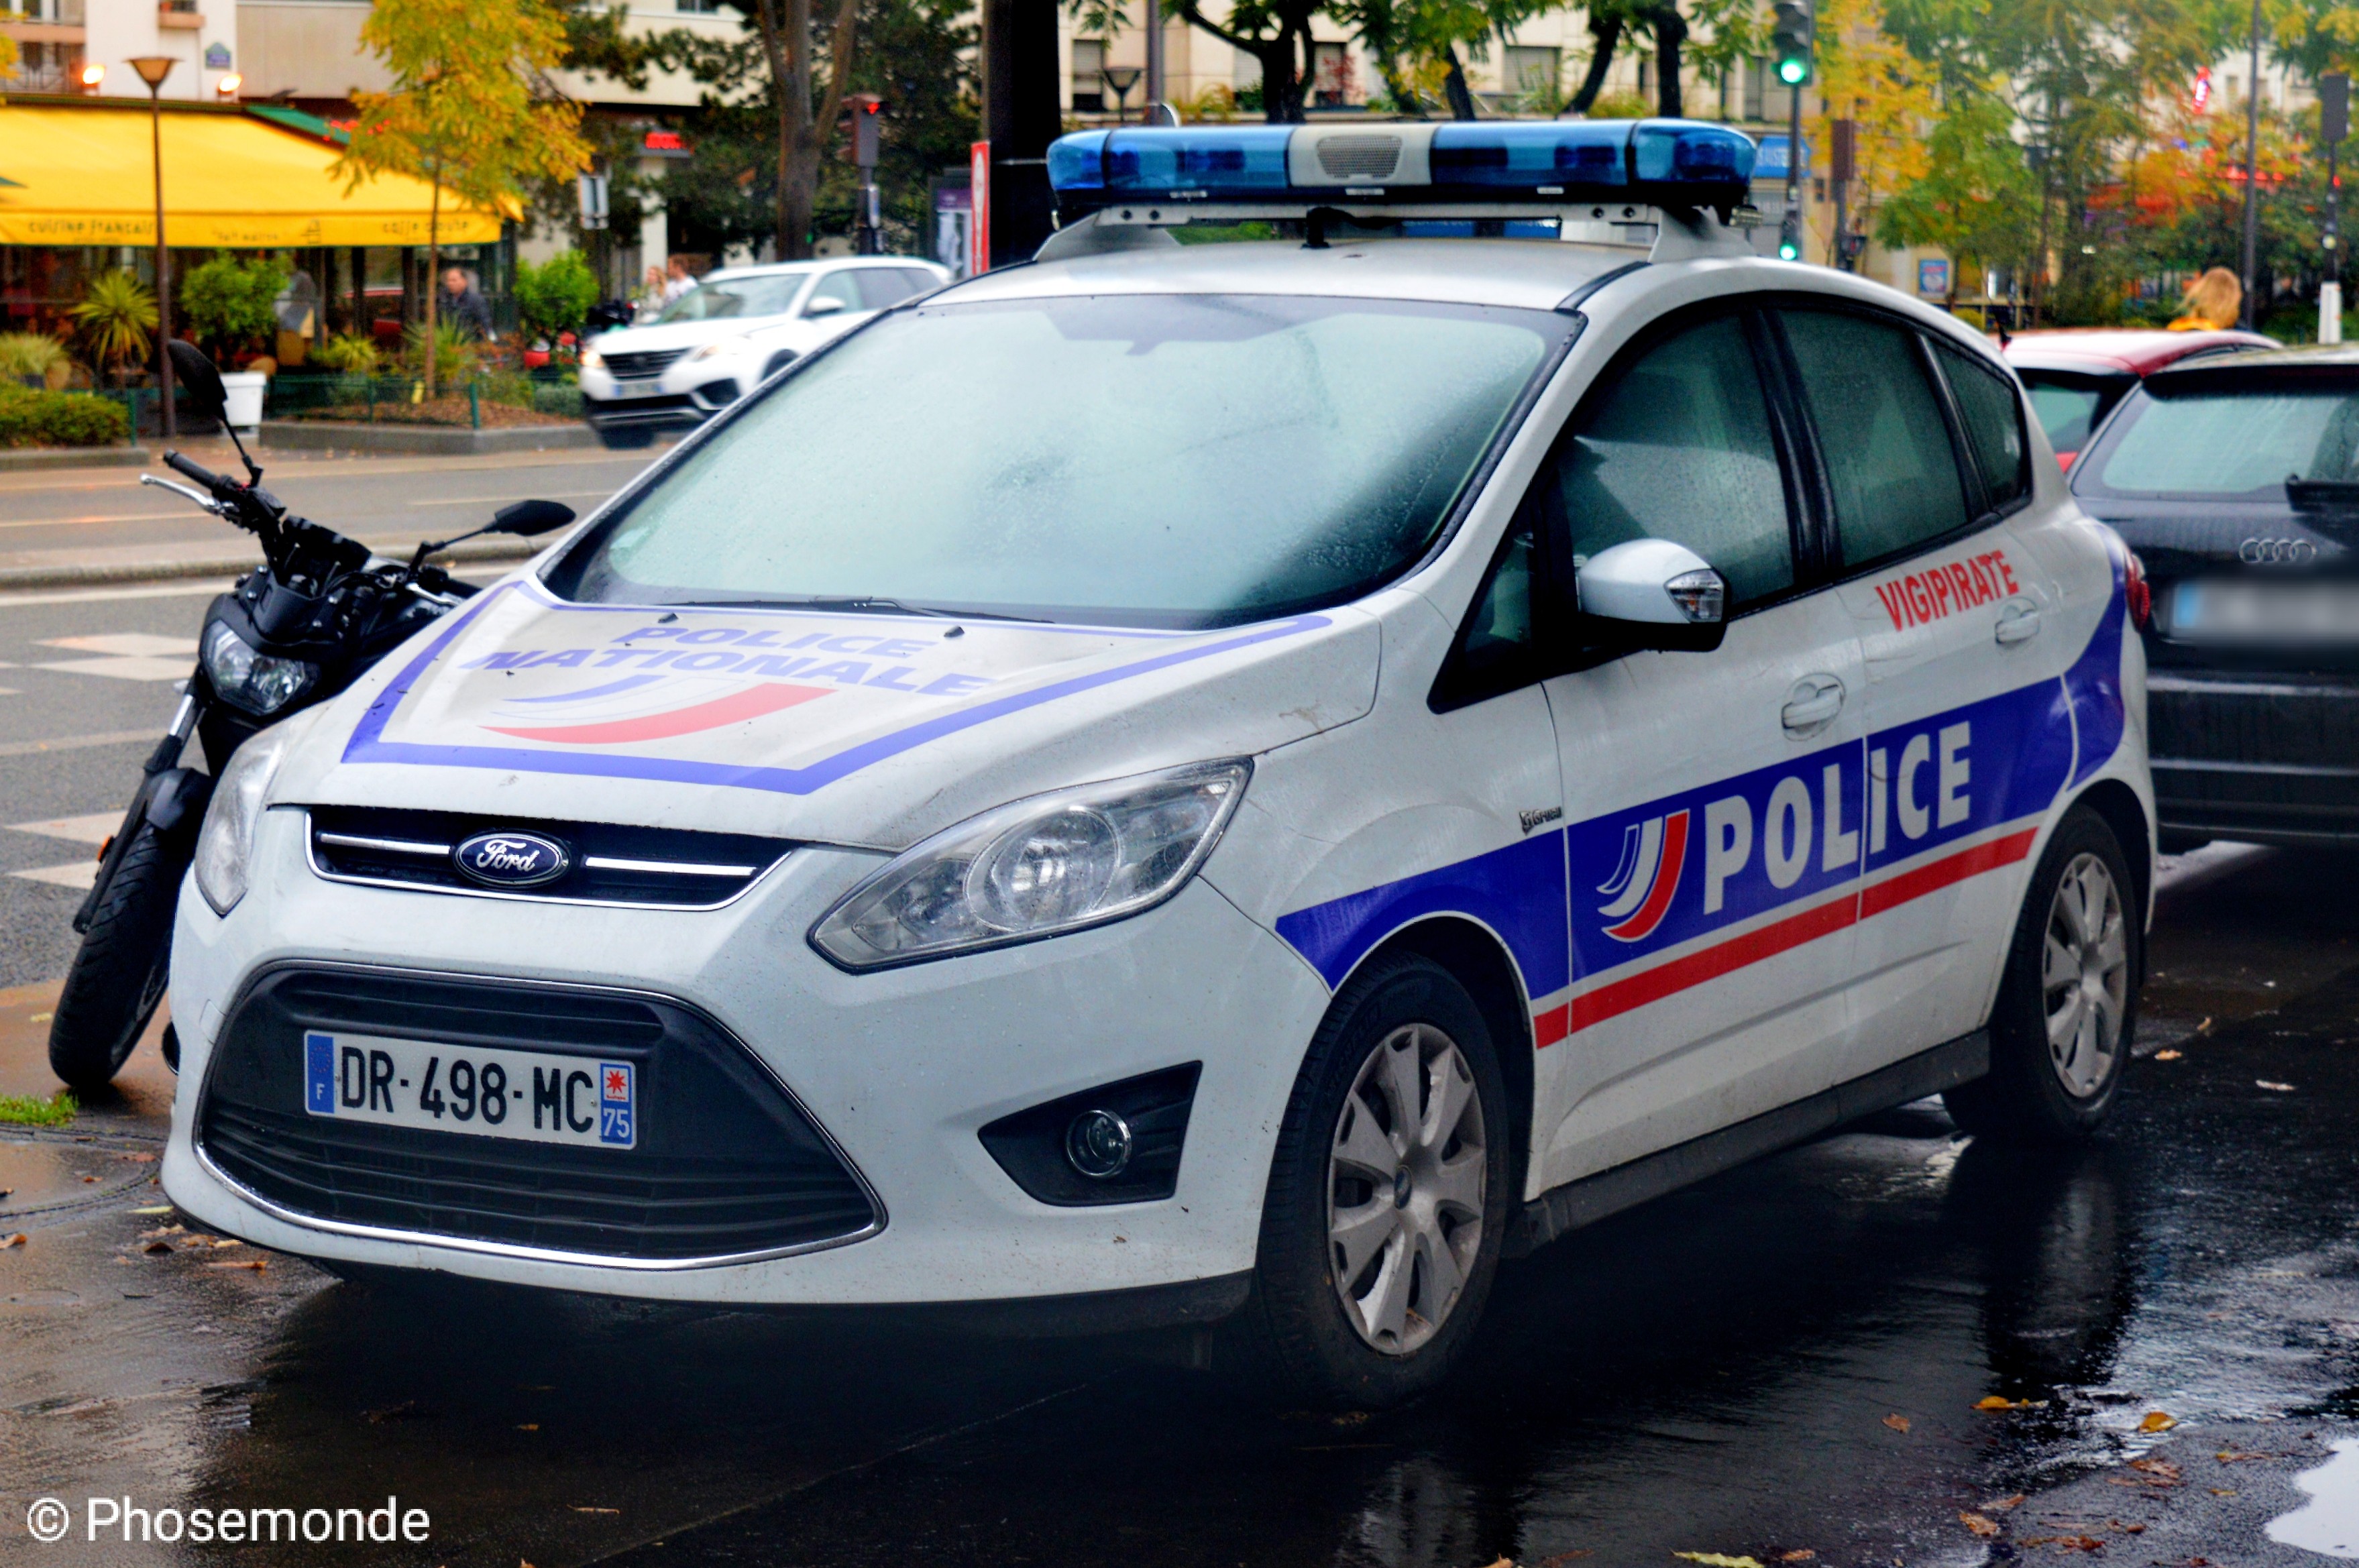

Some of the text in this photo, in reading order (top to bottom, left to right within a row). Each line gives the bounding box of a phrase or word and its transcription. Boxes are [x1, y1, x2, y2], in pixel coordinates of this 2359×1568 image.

[1874, 549, 2020, 632] VIGIPIRATE
[463, 649, 998, 697] NATIONALE
[611, 627, 941, 659] POLICE
[1703, 720, 1971, 915] POLICE
[476, 839, 540, 872] Ford
[317, 1046, 630, 1138] F DR-498-MC 75
